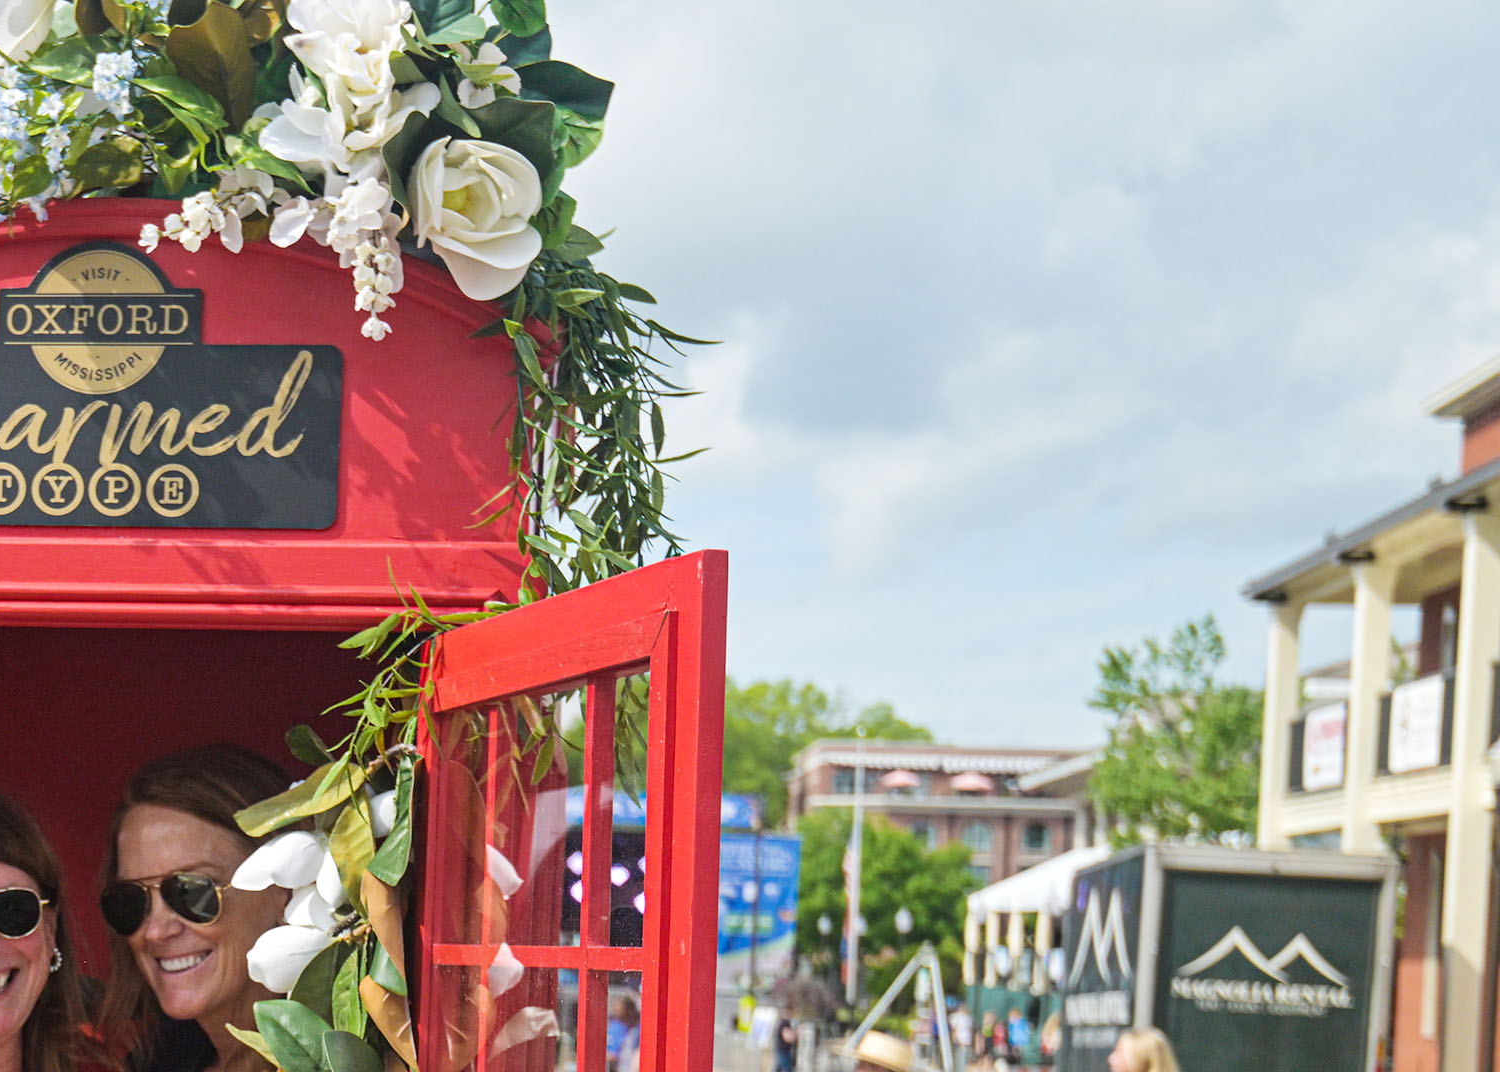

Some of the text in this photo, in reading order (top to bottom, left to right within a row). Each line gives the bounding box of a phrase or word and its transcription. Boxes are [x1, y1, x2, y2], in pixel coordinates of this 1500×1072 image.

[80, 267, 121, 282] VISIT
[6, 303, 190, 336] OXFORD
[53, 351, 143, 382] MISSISSIPPI
